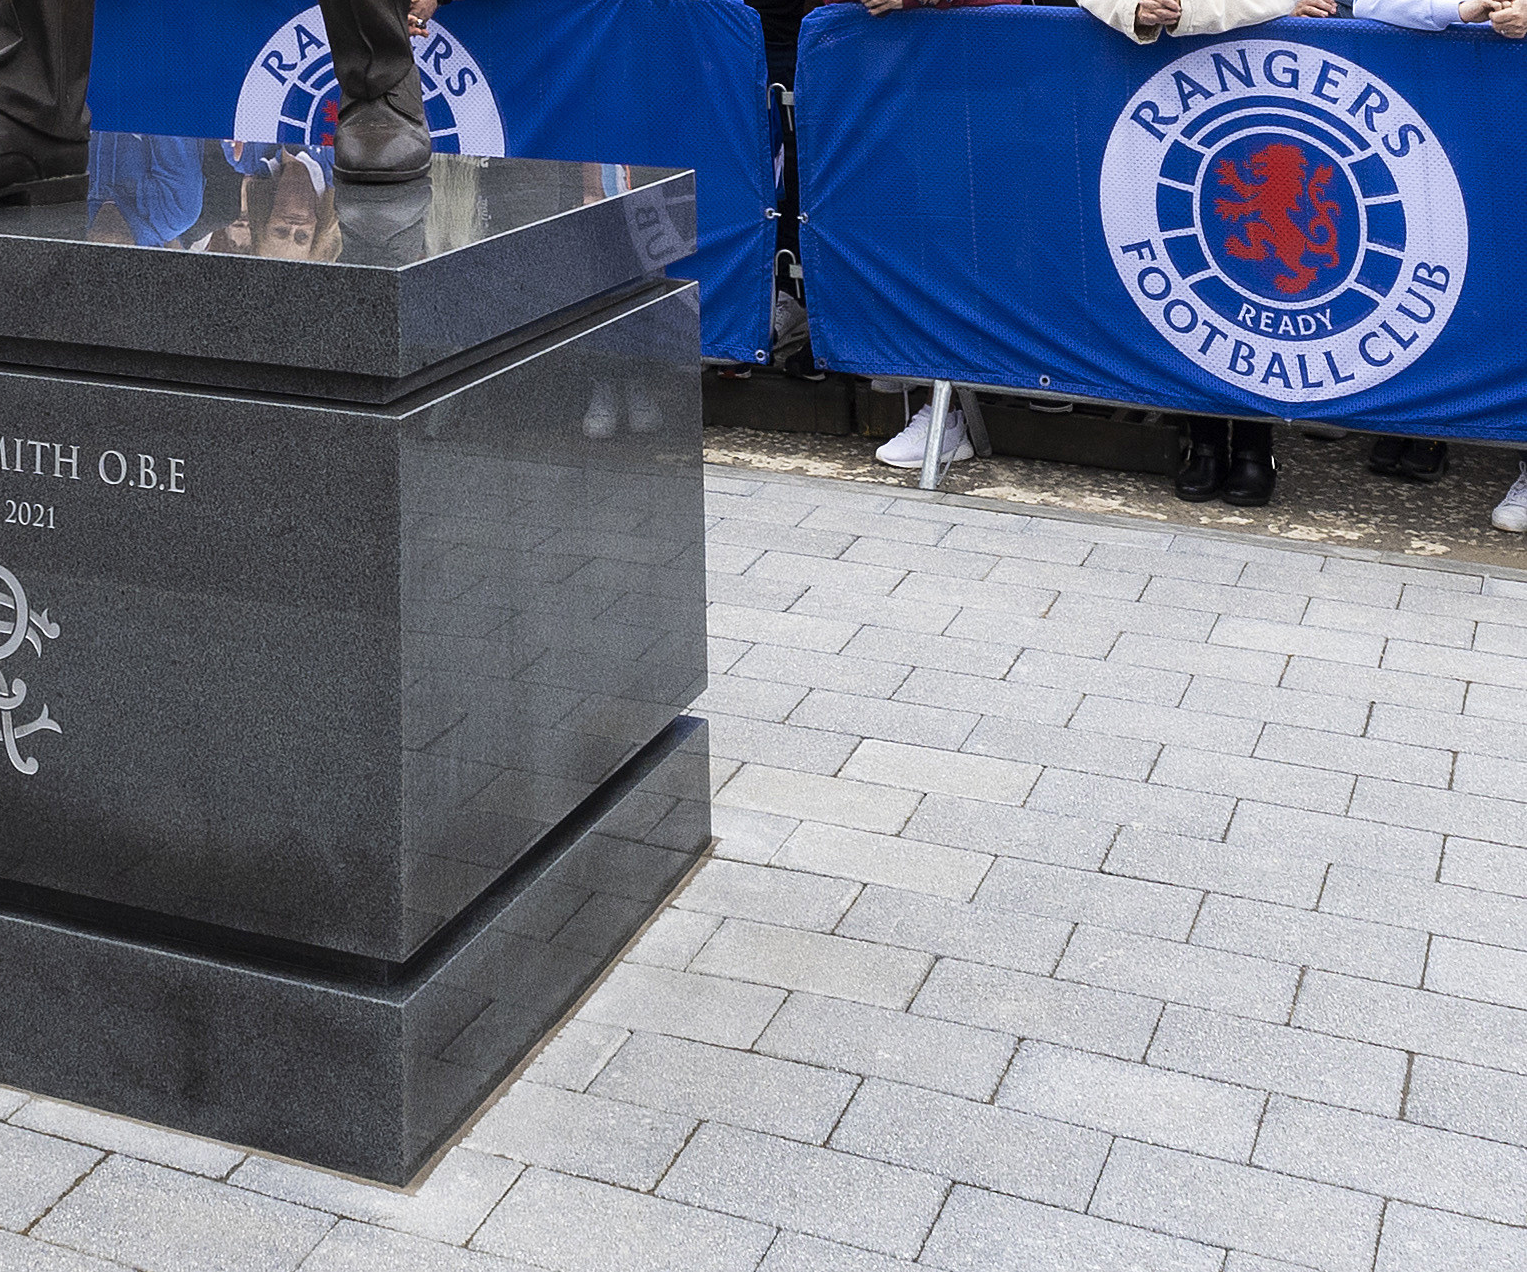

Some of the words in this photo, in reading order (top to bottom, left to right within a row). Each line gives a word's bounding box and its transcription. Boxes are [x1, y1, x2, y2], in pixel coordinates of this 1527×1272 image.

[261, 23, 478, 97] RARS
[1129, 48, 1427, 159] RANGERS
[1119, 238, 1356, 389] FOOTBALL
[1358, 261, 1451, 368] CLUB
[1236, 302, 1333, 336] READY
[98, 449, 187, 494] O.B.E
[4, 499, 57, 530] 2021
